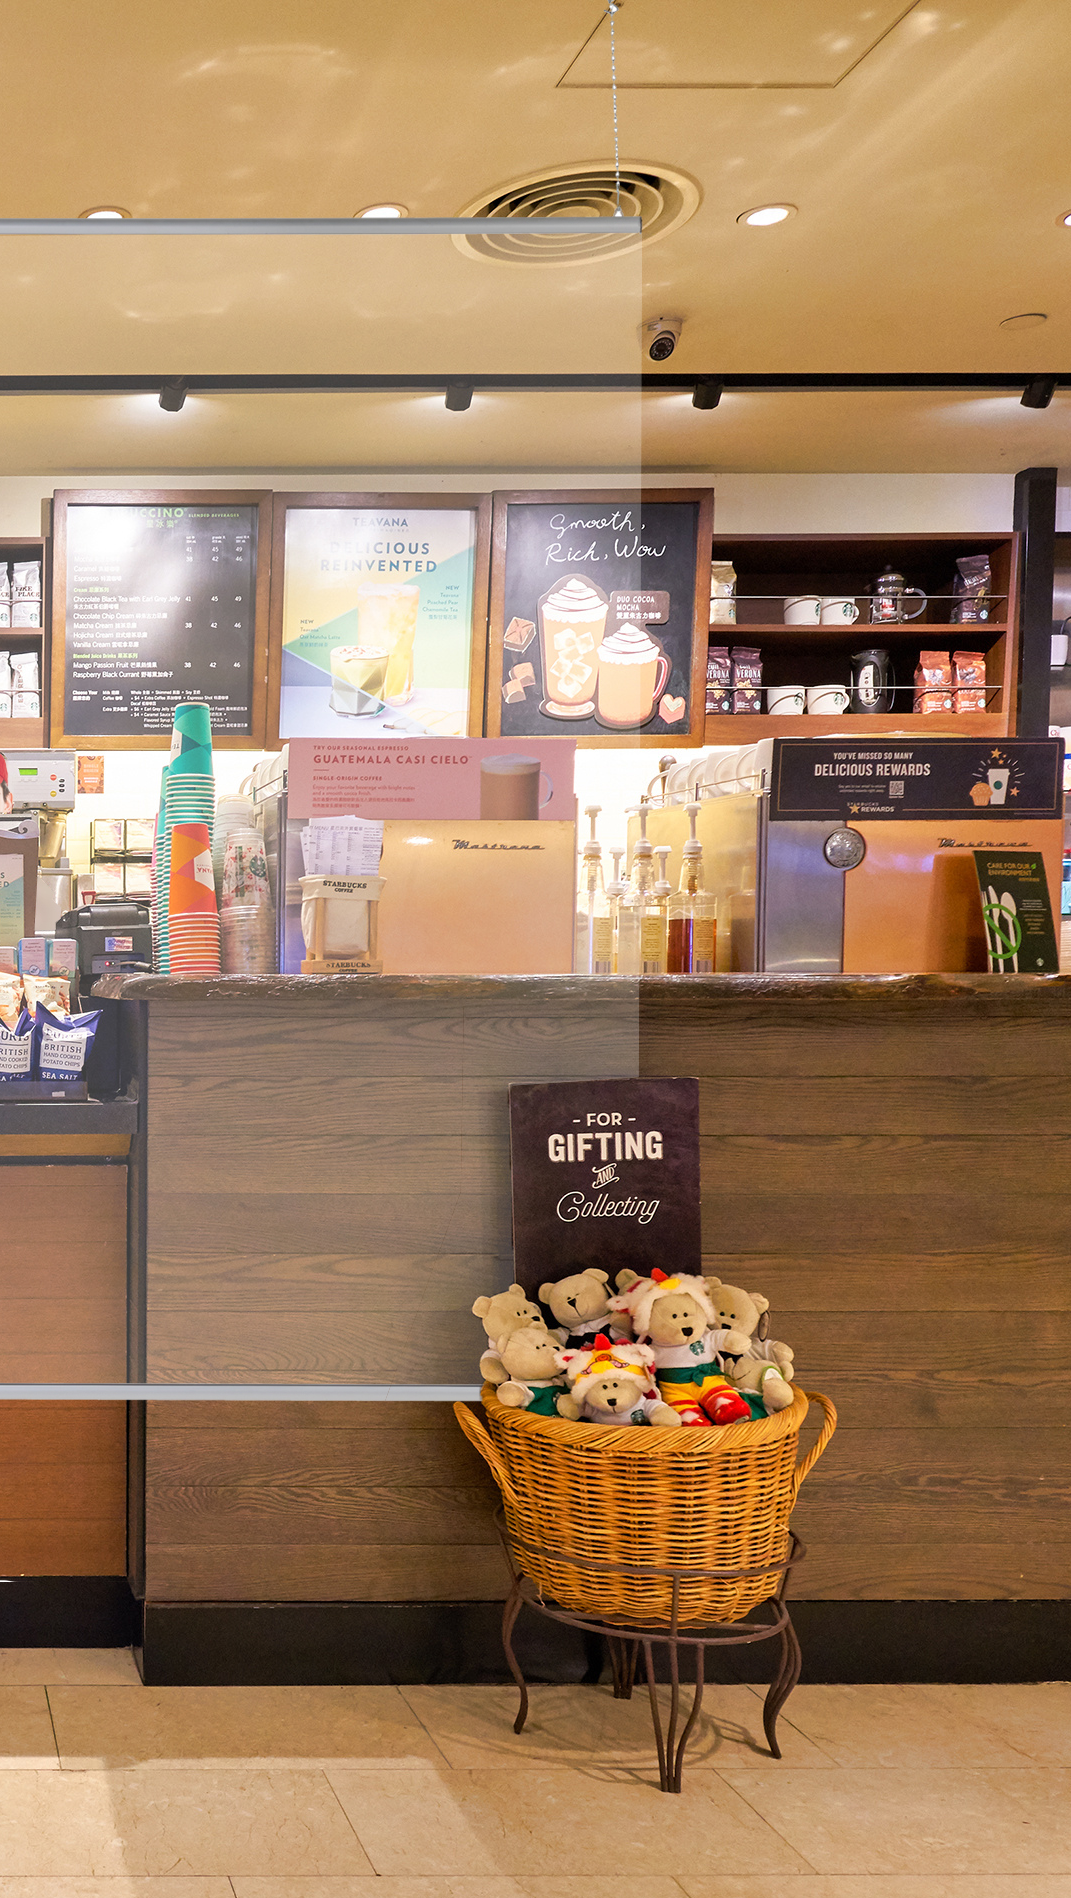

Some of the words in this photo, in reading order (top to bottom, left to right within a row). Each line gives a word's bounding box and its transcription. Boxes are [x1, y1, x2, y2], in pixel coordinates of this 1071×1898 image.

[545, 541, 609, 565] Rich,
[615, 536, 666, 558] Wow
[320, 560, 437, 572] REINVENTED
[737, 670, 760, 678] VERONA
[314, 755, 391, 764] GUATEMALA
[396, 755, 425, 764] CASI
[858, 752, 882, 760] MISSED
[884, 752, 892, 760] SO
[894, 752, 913, 760] MANY
[814, 764, 873, 776] DELICIOUS
[876, 764, 931, 776] REWARDS
[323, 880, 367, 889] STARBUCKS
[44, 1043, 82, 1053] BRITISH
[42, 1072, 56, 1080] SEA
[586, 1112, 622, 1126] FOR
[548, 1131, 663, 1163] GIFTING
[593, 1165, 617, 1187] AND
[557, 1191, 660, 1224] Collecting
